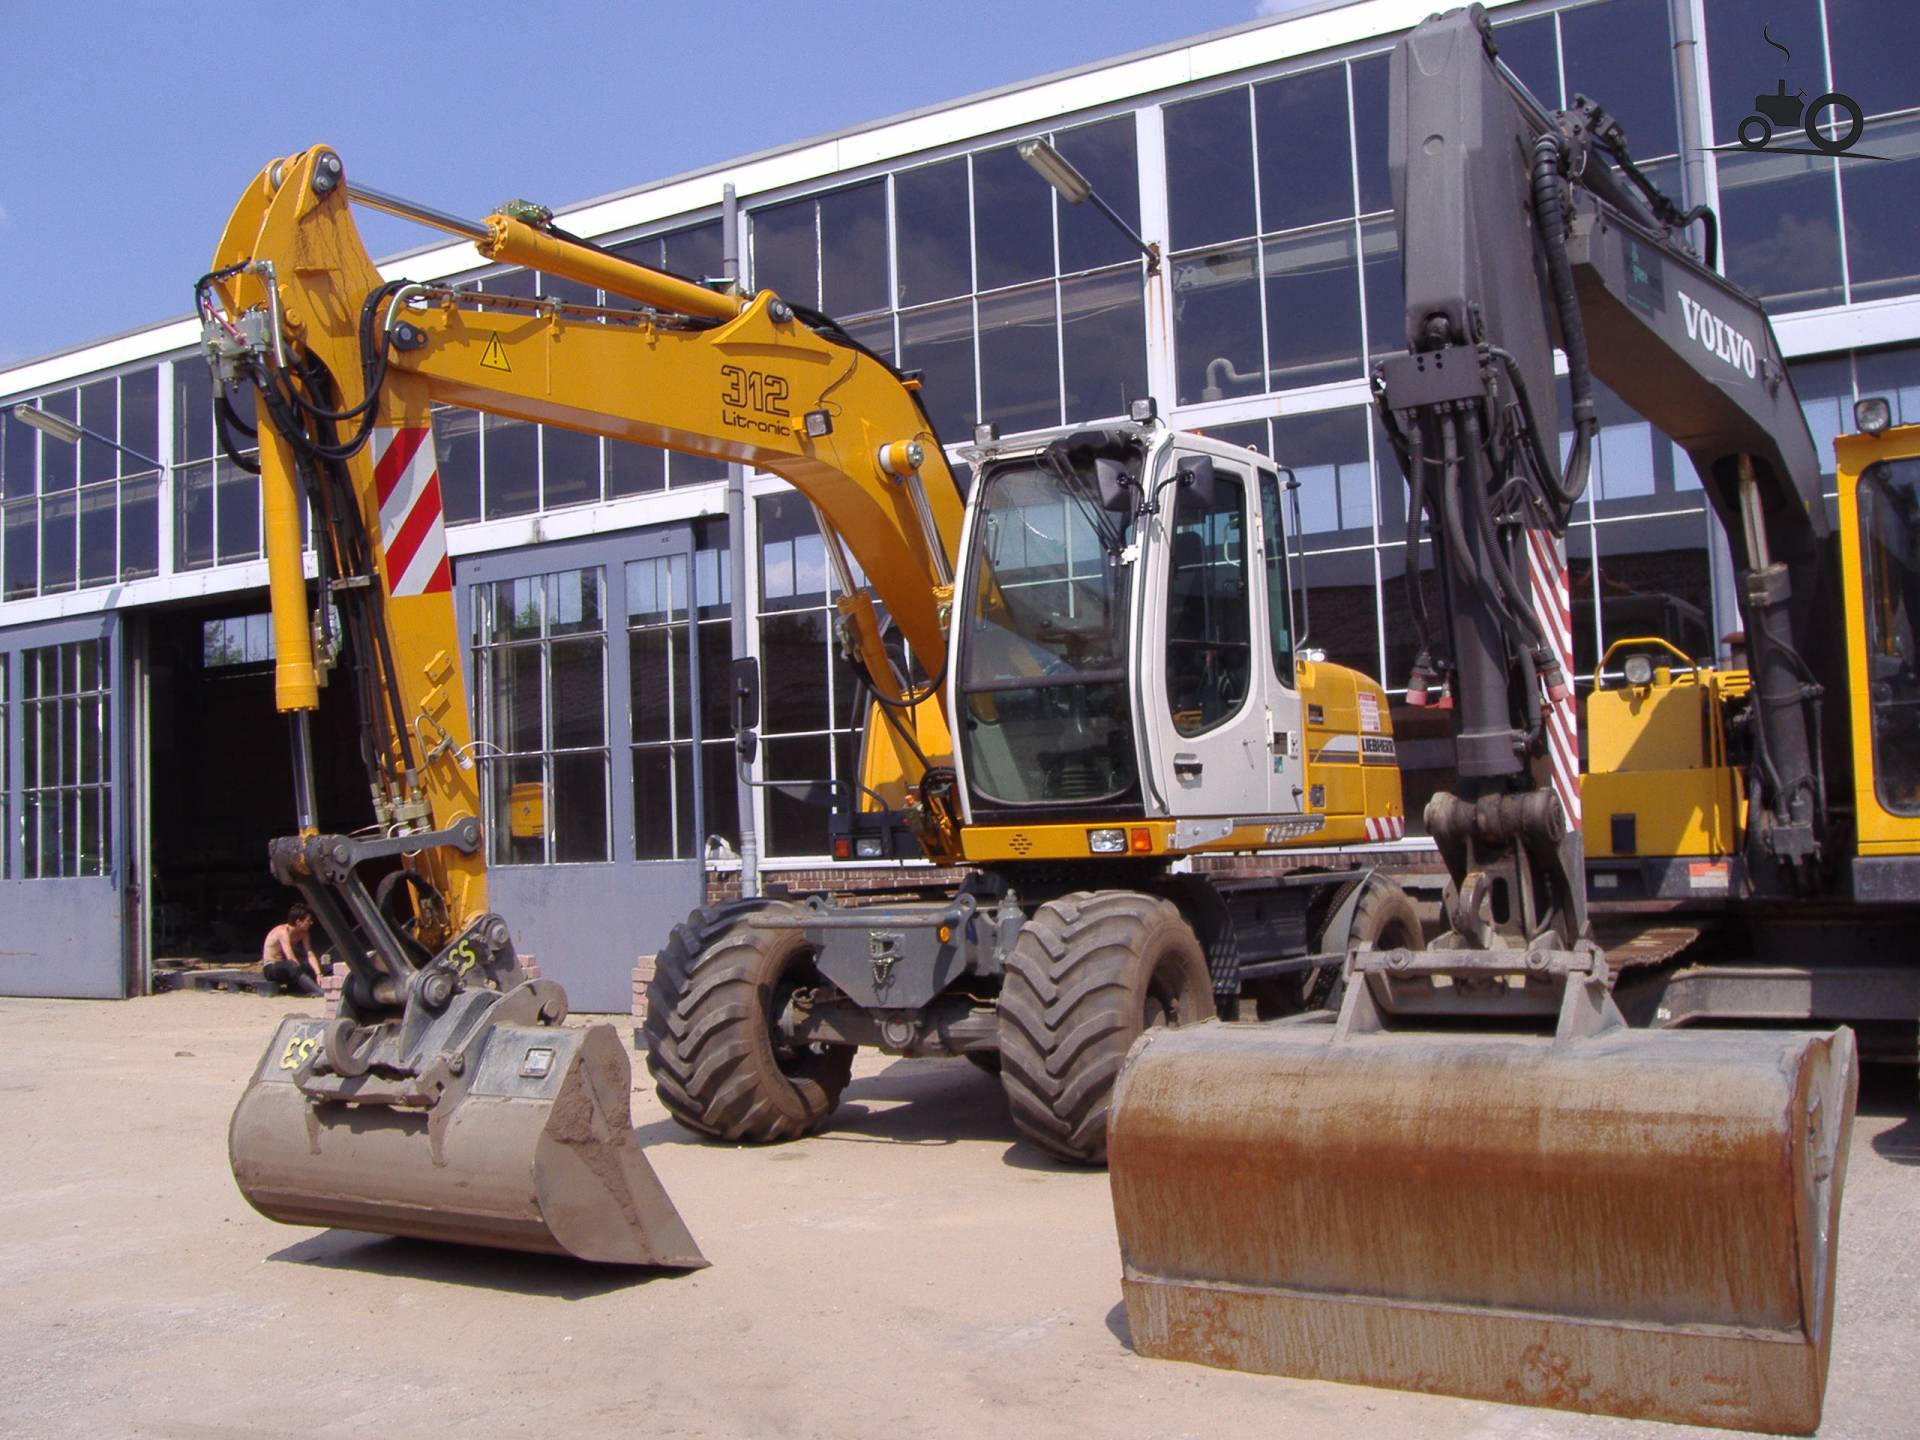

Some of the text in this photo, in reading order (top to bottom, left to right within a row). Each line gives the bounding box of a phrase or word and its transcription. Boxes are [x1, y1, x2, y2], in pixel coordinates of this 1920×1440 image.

[1677, 290, 1756, 379] VOLVO
[721, 364, 790, 417] 312
[722, 409, 791, 437] Litronic
[1361, 737, 1394, 753] LIEBHERR
